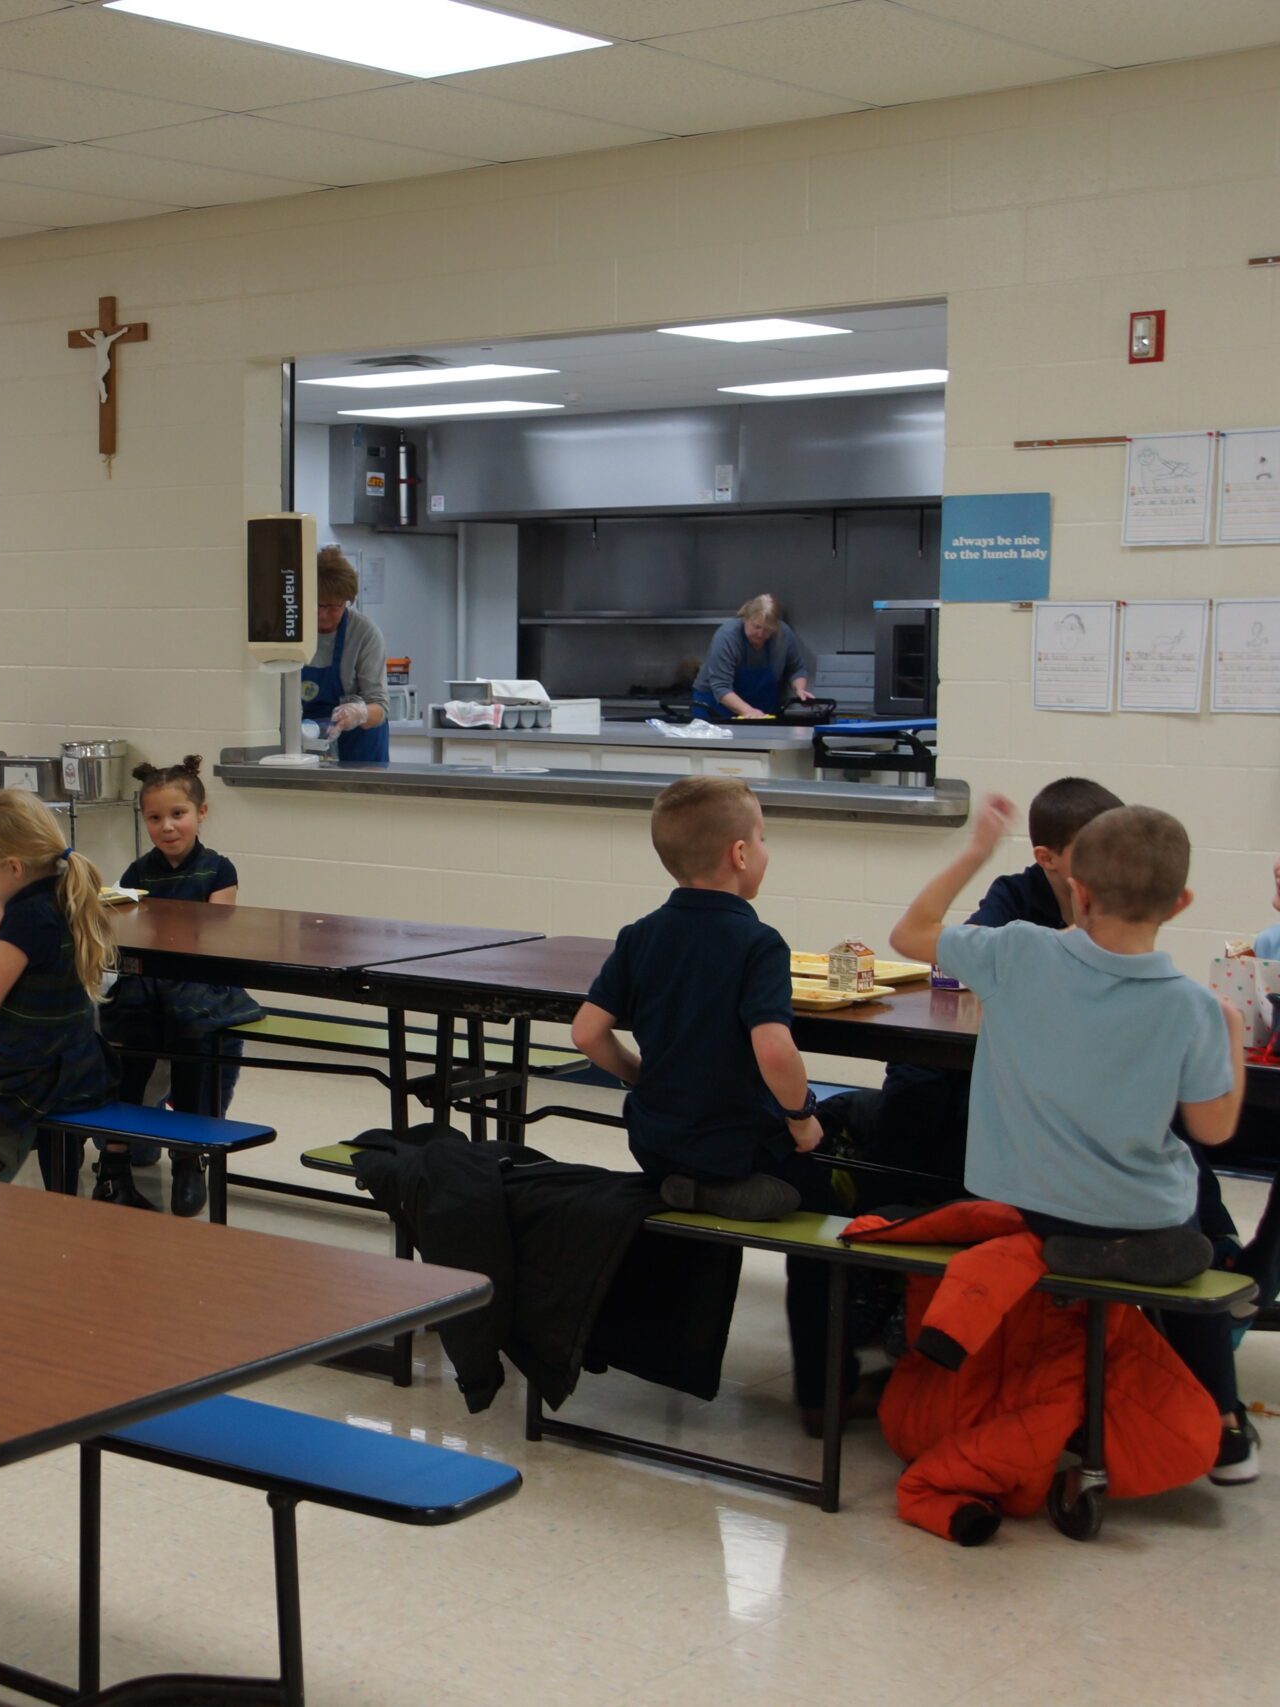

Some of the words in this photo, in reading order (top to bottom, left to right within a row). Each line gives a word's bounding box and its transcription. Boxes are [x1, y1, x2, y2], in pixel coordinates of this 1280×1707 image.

[952, 536, 994, 548] always
[997, 536, 1012, 545] be
[1014, 535, 1040, 545] nice
[944, 551, 957, 559] to
[960, 550, 980, 559] the
[983, 549, 1017, 559] lunch
[1021, 549, 1048, 560] lady
[282, 574, 298, 637] napkins
